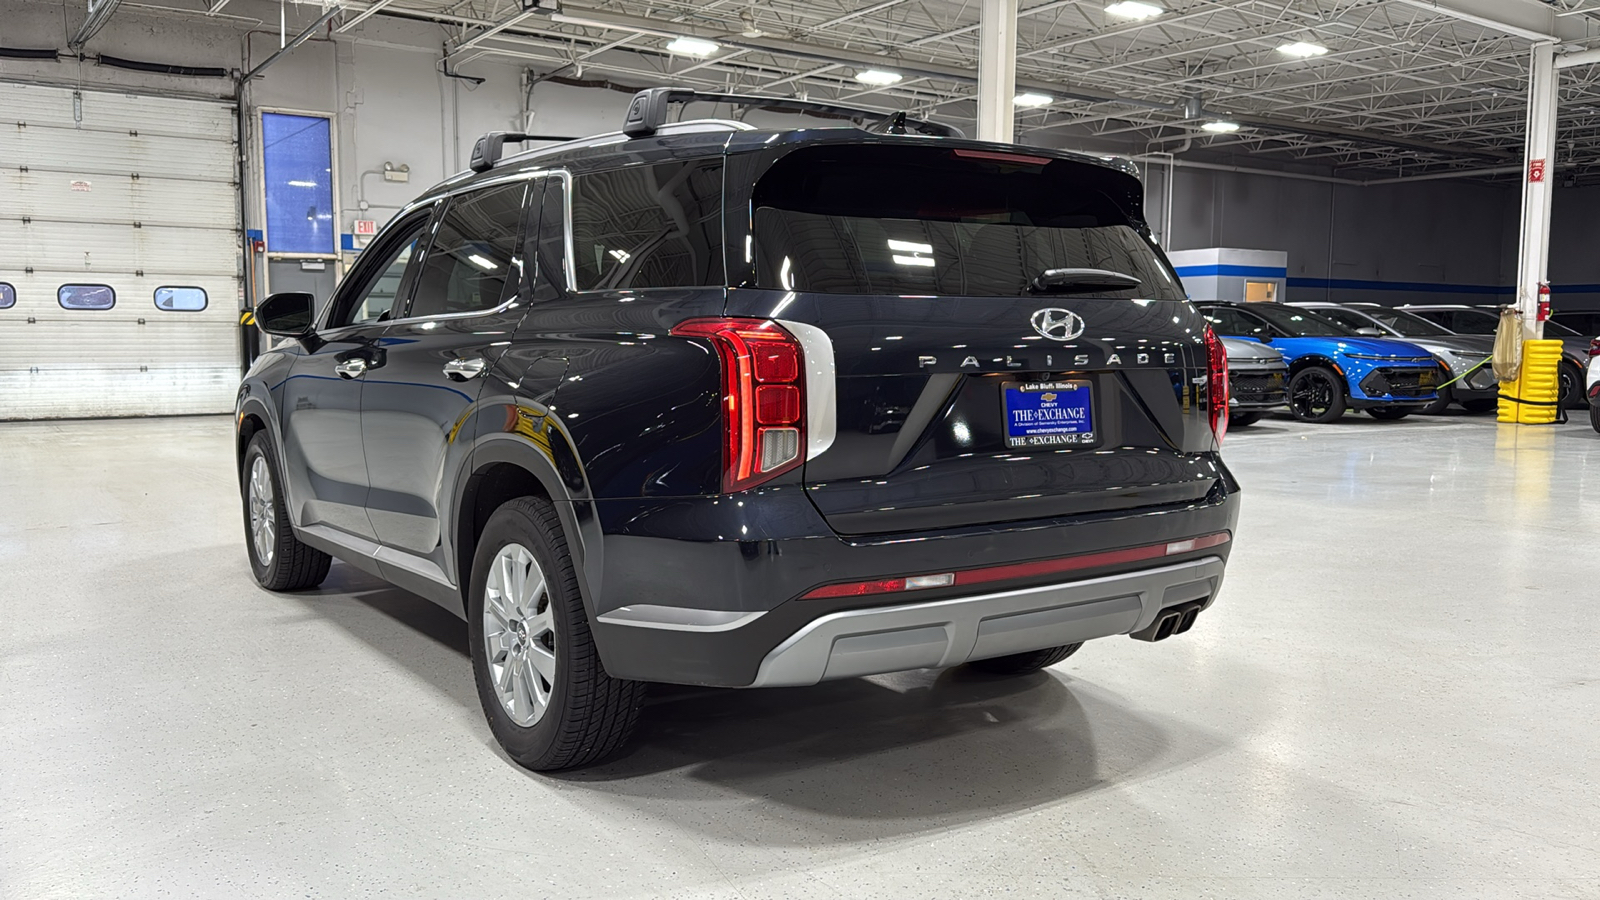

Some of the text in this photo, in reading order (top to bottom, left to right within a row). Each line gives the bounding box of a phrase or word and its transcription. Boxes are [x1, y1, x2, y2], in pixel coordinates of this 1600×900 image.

[358, 220, 374, 233] EXIT
[918, 353, 1176, 368] PALISADE
[1013, 408, 1085, 421] THE EXCHANGE
[1010, 437, 1026, 446] THE
[1034, 434, 1077, 444] EXCHANGE
